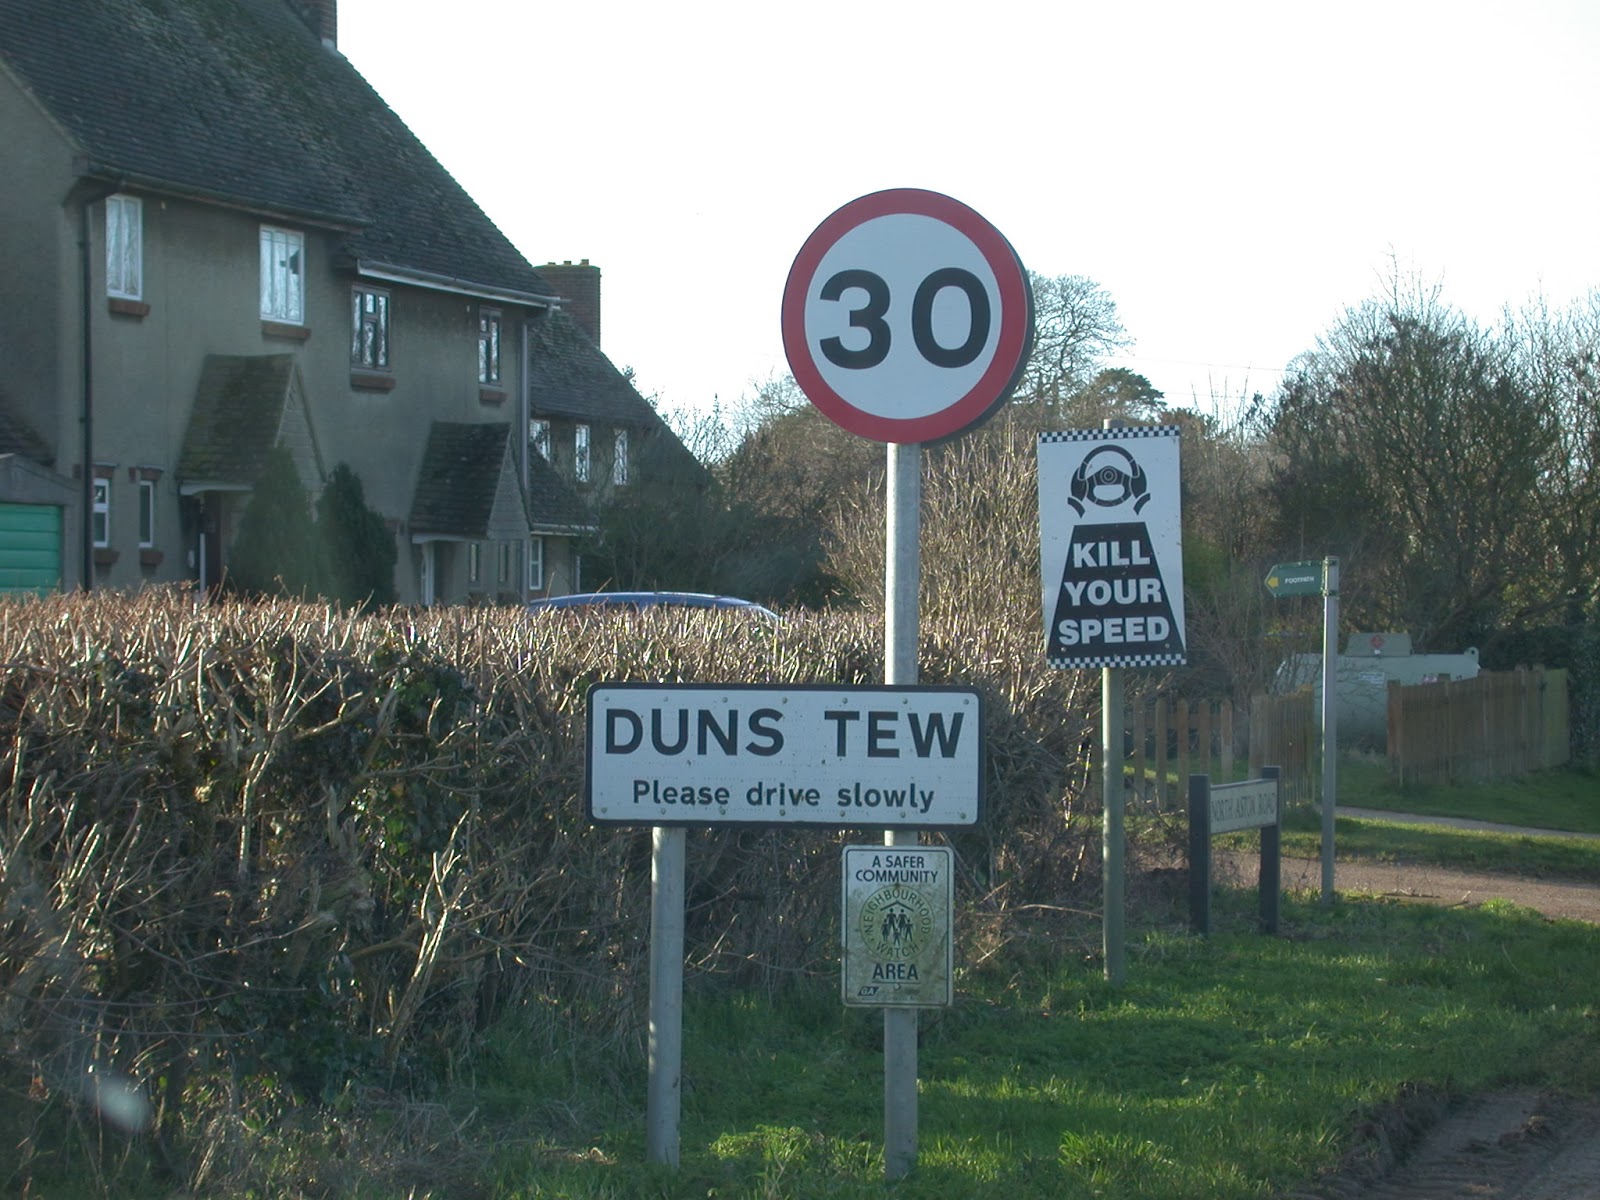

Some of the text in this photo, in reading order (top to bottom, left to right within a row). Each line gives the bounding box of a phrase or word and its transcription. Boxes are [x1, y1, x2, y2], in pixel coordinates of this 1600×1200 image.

[819, 267, 991, 370] 30
[1073, 540, 1150, 568] KILL
[1064, 578, 1162, 606] YOUR
[1284, 576, 1315, 584] FOOTPATH
[1058, 616, 1170, 645] SPEED
[605, 708, 964, 758] DUNS TEW
[633, 780, 934, 813] Please drive slowly
[872, 855, 924, 868] A SAFER
[855, 870, 938, 883] COMMUNITY
[864, 889, 931, 934] NEIGHBOURHOOD
[876, 941, 920, 959] WATCH
[872, 963, 918, 981] AREA
